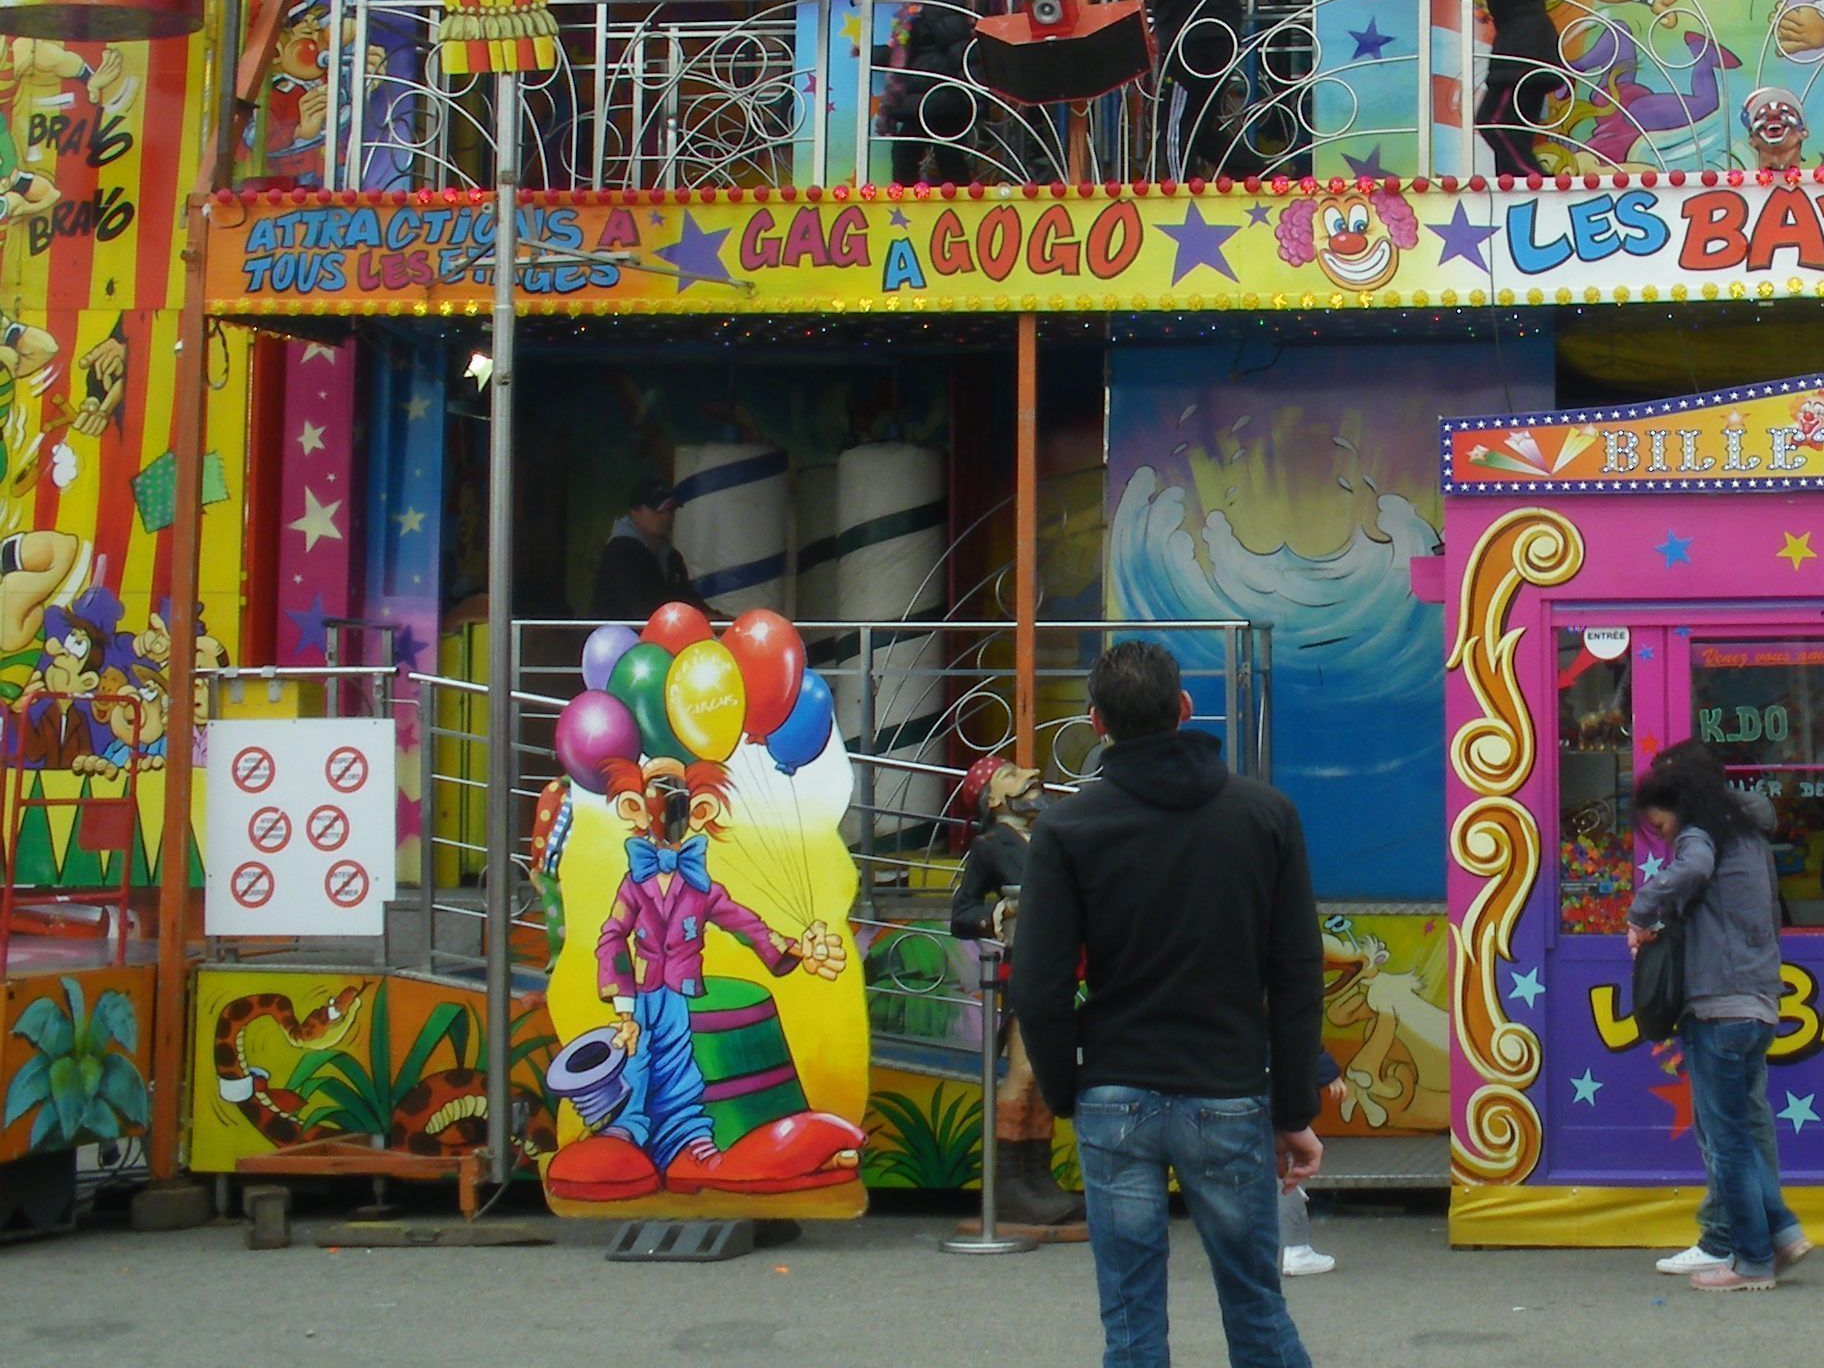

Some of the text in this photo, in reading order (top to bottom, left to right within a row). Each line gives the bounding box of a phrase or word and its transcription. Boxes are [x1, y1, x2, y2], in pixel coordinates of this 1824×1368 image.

[28, 106, 133, 168] BRAVO
[29, 186, 135, 257] BRAVO
[597, 208, 642, 248] A
[738, 204, 872, 272] GAG
[928, 198, 1145, 282] GOGO
[1505, 189, 1671, 275] LES
[243, 246, 348, 294] TOUS
[356, 247, 435, 292] LES
[1587, 630, 1626, 641] ENTRÉE
